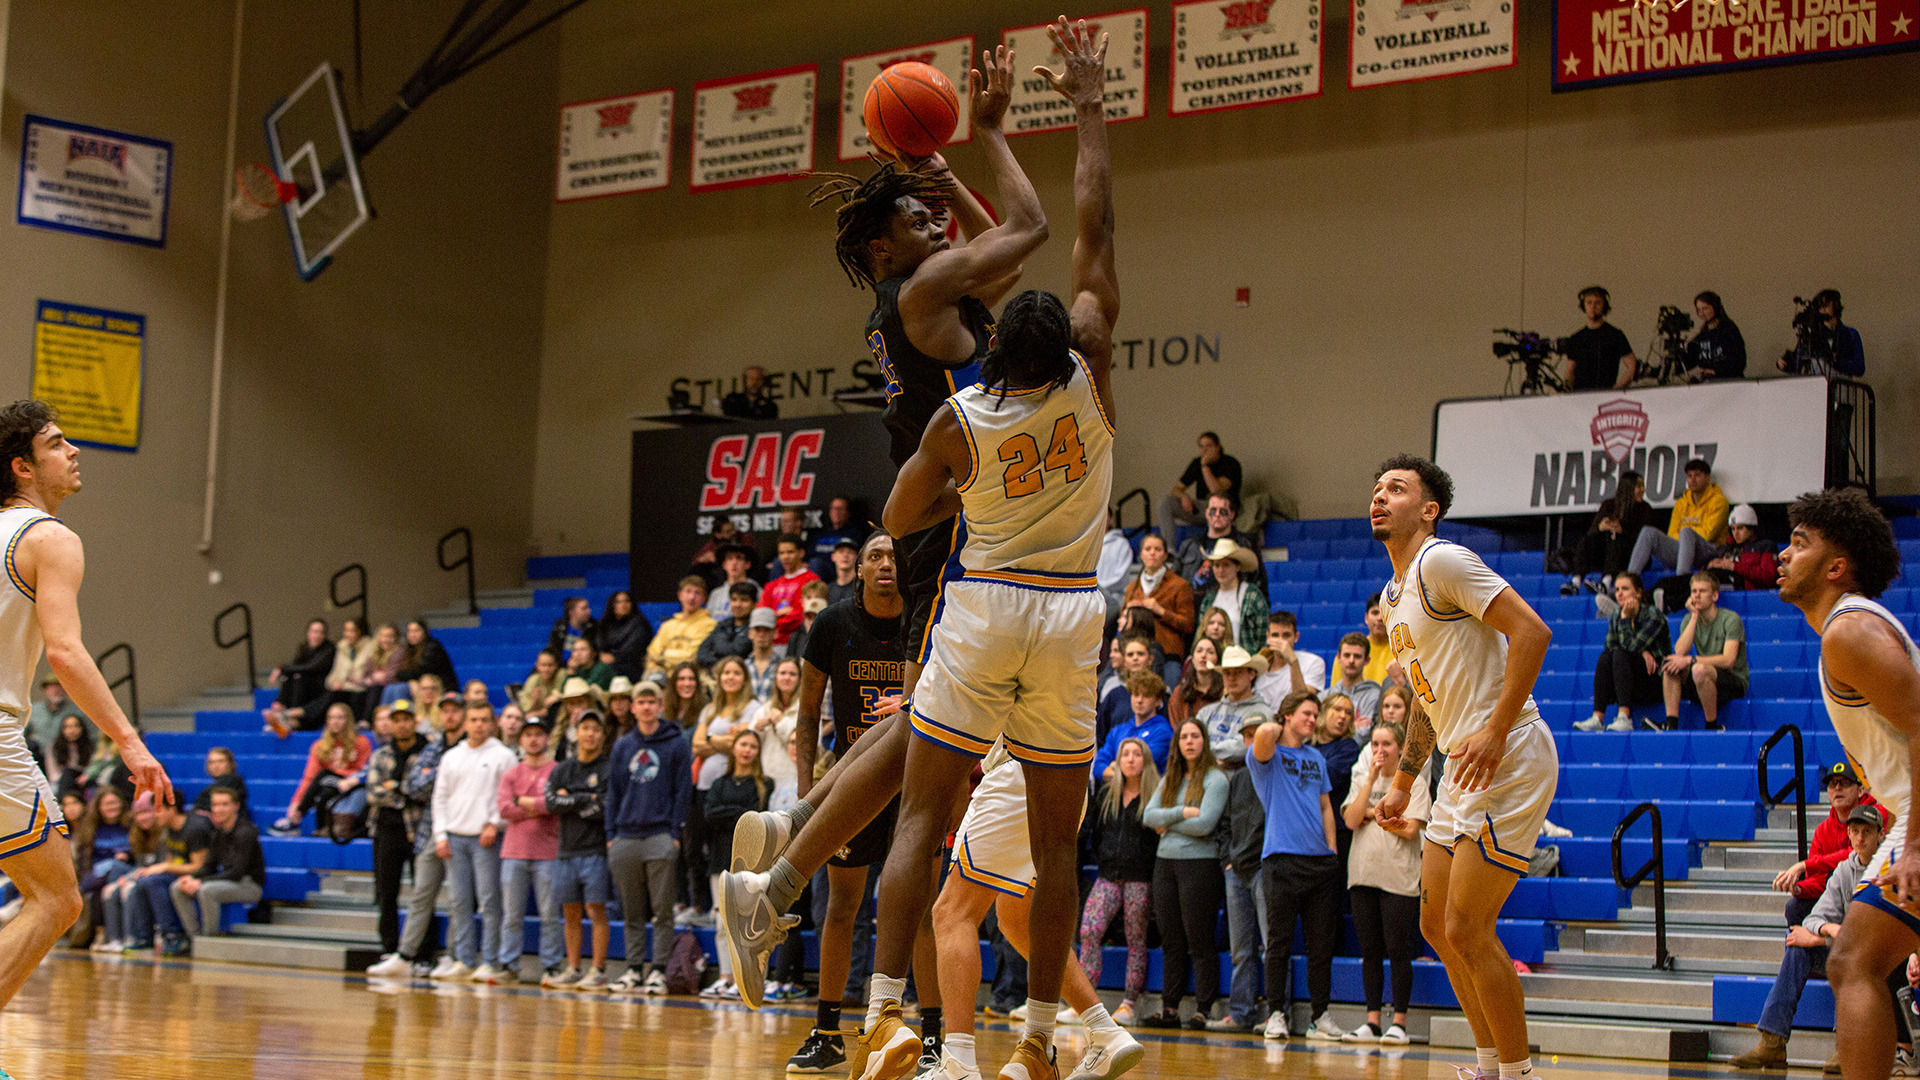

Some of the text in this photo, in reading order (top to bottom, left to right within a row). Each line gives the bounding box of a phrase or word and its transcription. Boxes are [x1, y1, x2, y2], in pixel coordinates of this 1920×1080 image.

[1374, 21, 1490, 50] VOLLEYBALL
[1592, 2, 1669, 44] MENS
[1195, 42, 1300, 70] VOLLEYBALL
[1593, 9, 1877, 76] NATIONAL CHAMPION
[1356, 43, 1510, 75] CO-CHAMPIONS
[1181, 64, 1313, 92] TOURNAMENT
[1009, 88, 1138, 115] TOURNENT
[1189, 82, 1304, 108] CHAMPIONS
[1016, 106, 1129, 129] CHAMNS
[738, 124, 804, 143] BASKETBALL
[699, 143, 805, 168] TOURNAMENT
[570, 168, 658, 189] CHAMPIONS
[703, 159, 798, 181] CHAMPIONS
[670, 367, 836, 405] STUENT
[1595, 413, 1644, 431] INTEGRITY
[997, 412, 1088, 499] 24
[699, 428, 825, 511] SAC
[696, 513, 751, 535] SPTS
[849, 660, 906, 681] CENTRA
